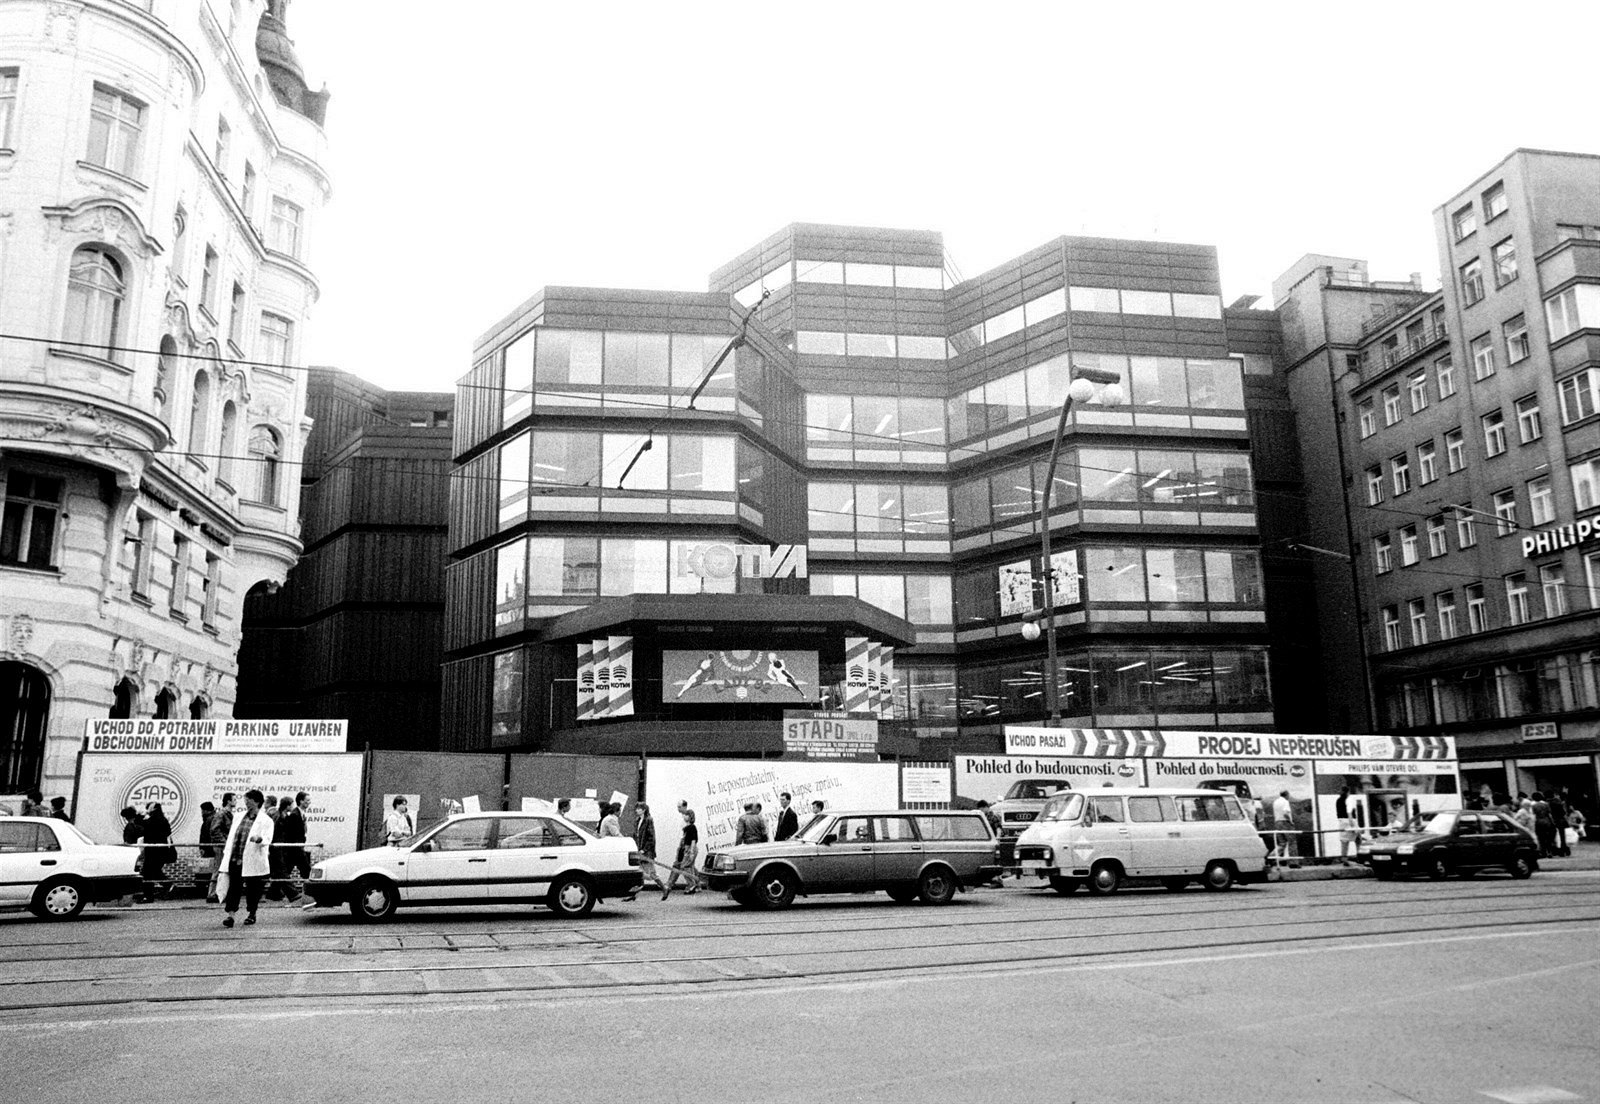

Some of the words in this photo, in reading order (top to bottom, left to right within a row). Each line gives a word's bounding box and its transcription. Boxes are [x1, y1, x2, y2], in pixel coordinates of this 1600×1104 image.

[1522, 515, 1600, 558] PHILIPS
[677, 544, 807, 578] KOTVA
[94, 721, 135, 735] VCHOD
[138, 721, 155, 735] DO
[158, 721, 217, 735] POTRAVIN
[225, 722, 279, 736] PARKING
[289, 720, 342, 736] UZAVŘEN
[788, 720, 844, 739] STAPO
[93, 735, 165, 750] OBCHODNÍM
[169, 736, 214, 750] DOMEM
[1009, 734, 1036, 747] VCHOD
[1039, 733, 1066, 748] PASÁŽÍ
[1198, 736, 1261, 755] PRODEJ
[1268, 736, 1361, 756] NEPŘERUŠEN
[215, 768, 260, 776] STAVEBNÍ
[262, 768, 293, 776] PRÁCE
[966, 759, 1011, 774] Pohled
[1015, 760, 1032, 774] do
[1035, 760, 1115, 775] budoucnosti.
[1156, 761, 1196, 775] Pohled
[1199, 761, 1214, 775] do
[1216, 762, 1288, 776] budoucnosti.
[131, 785, 178, 800] STAPO
